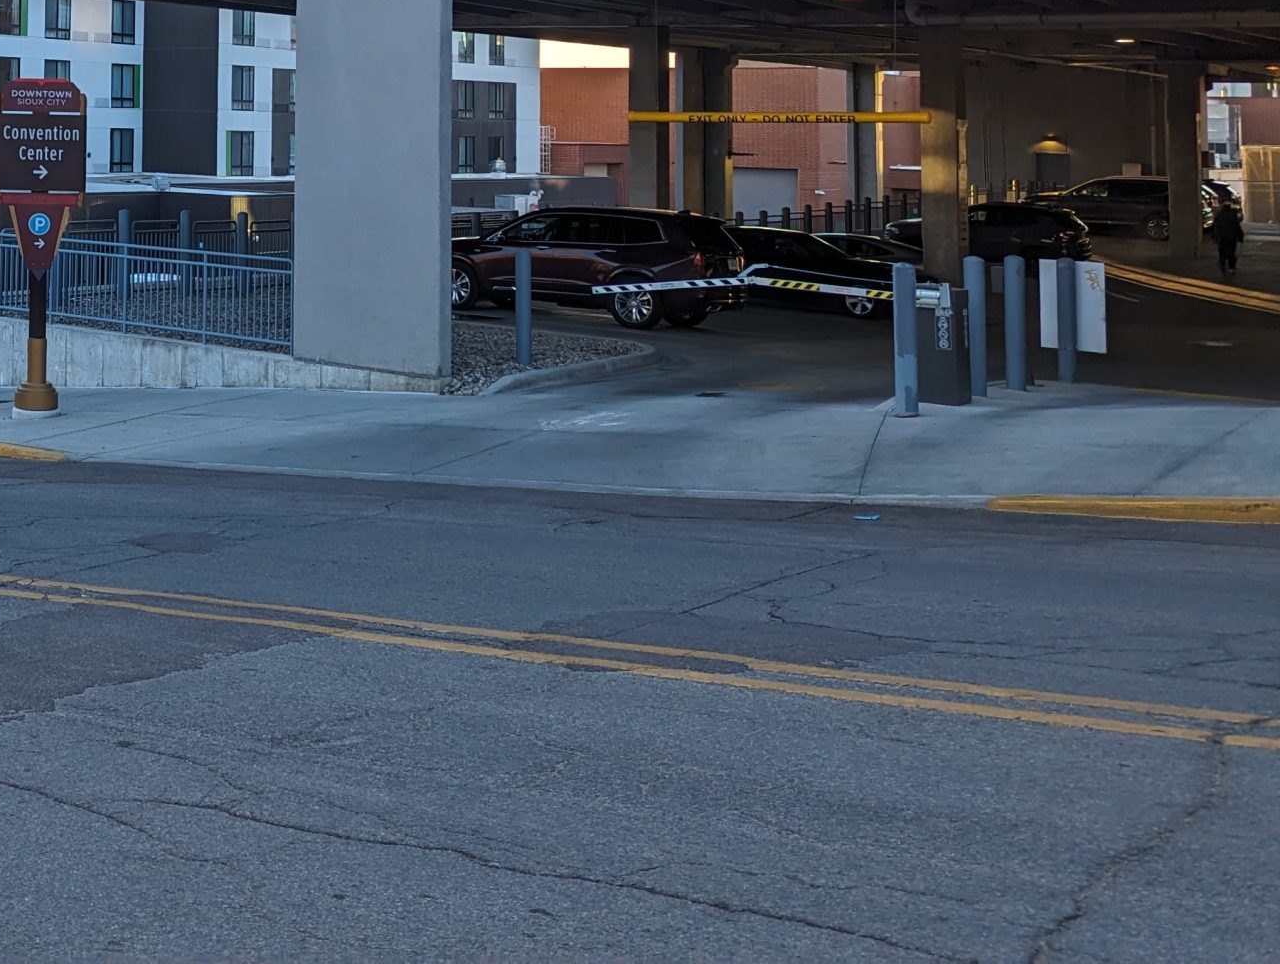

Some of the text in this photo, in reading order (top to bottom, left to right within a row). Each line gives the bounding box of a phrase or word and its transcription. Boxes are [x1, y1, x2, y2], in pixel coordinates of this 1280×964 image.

[11, 89, 72, 98] DOWNTOWN
[46, 98, 66, 106] CITY
[688, 115, 713, 123] EXIT
[718, 115, 747, 123] ONLY
[762, 115, 781, 123] DO
[785, 115, 810, 123] NOT
[815, 115, 857, 123] ENTER
[3, 125, 80, 141] Convention
[19, 146, 64, 161] Center
[34, 217, 46, 231] P
